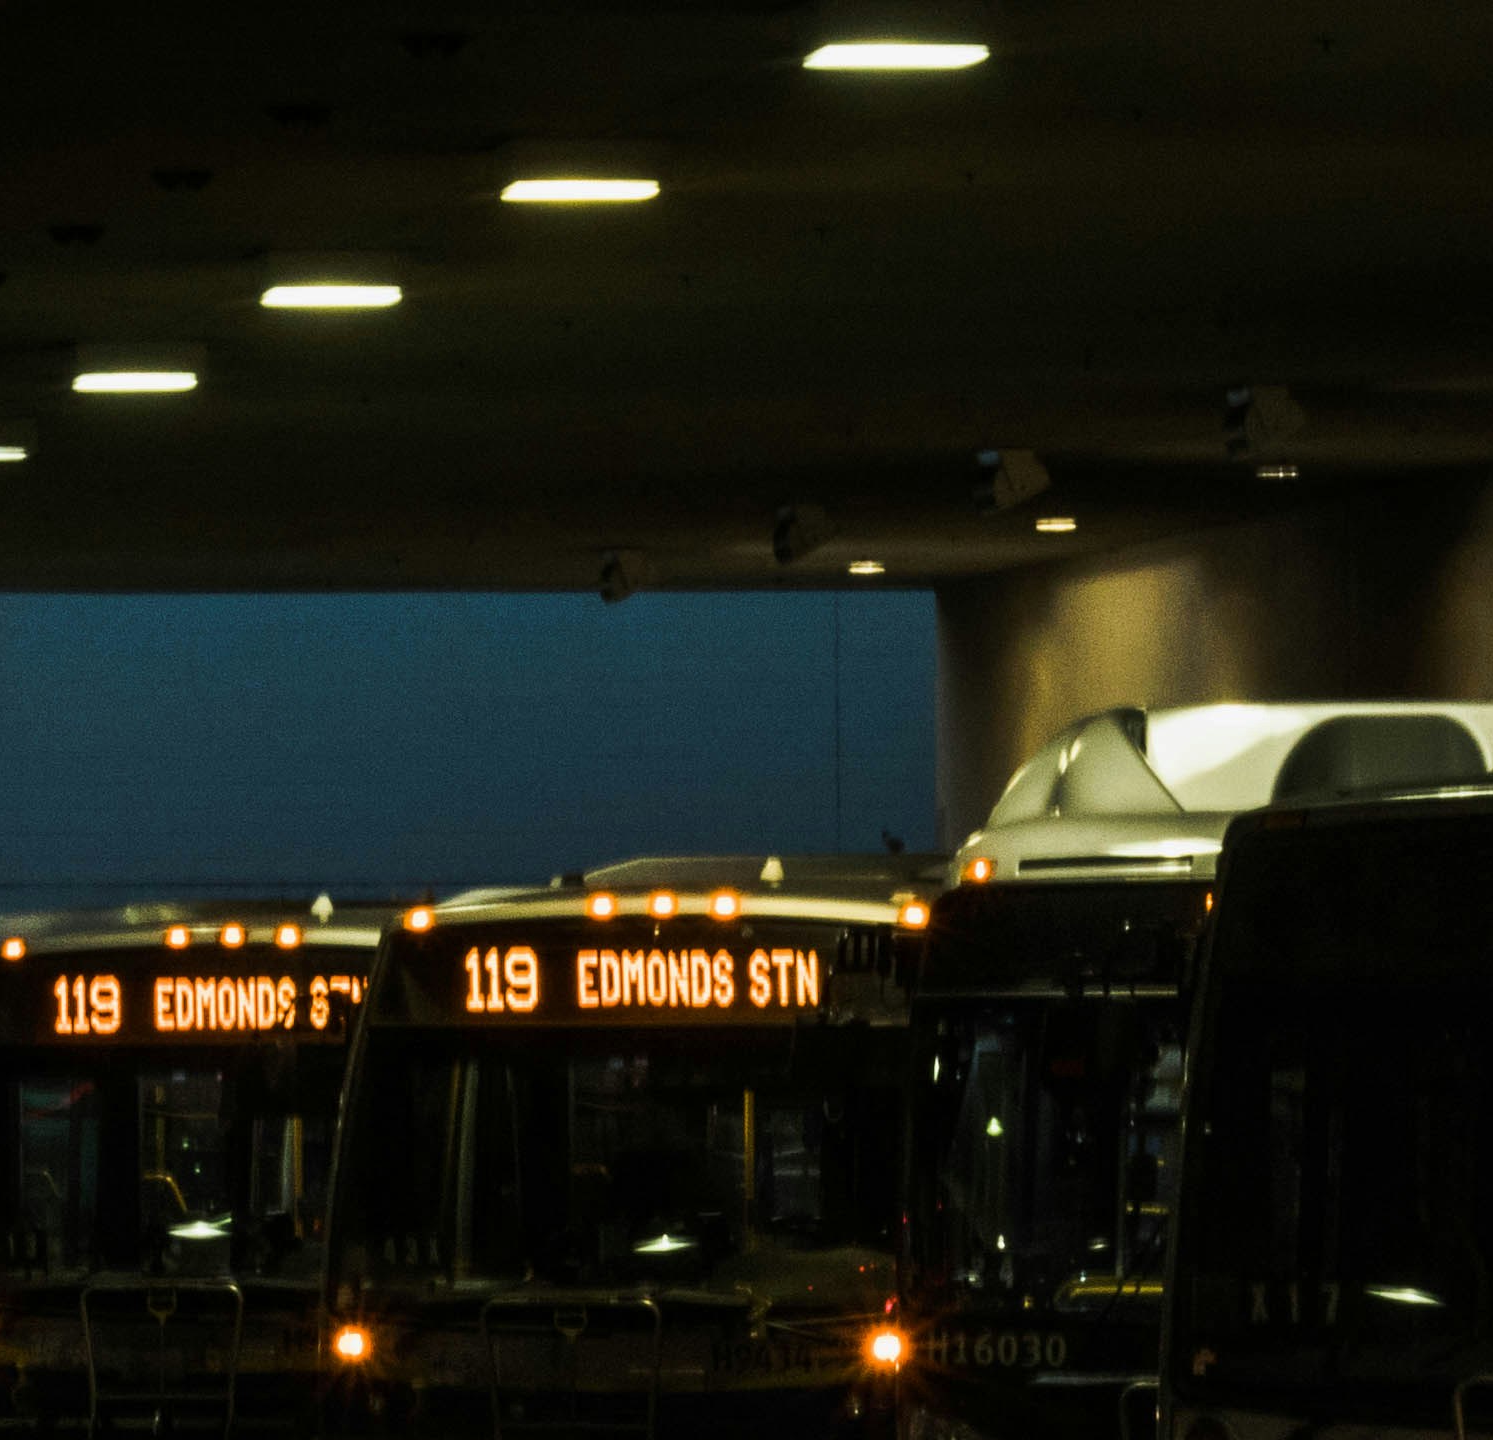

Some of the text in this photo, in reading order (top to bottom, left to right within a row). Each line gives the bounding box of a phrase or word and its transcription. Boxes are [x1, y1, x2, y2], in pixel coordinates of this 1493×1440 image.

[54, 973, 121, 1034] 119
[153, 974, 296, 1031] EDMONDS
[465, 945, 819, 1013] 119 EDMONDS STN
[927, 1328, 1068, 1369] H16030
